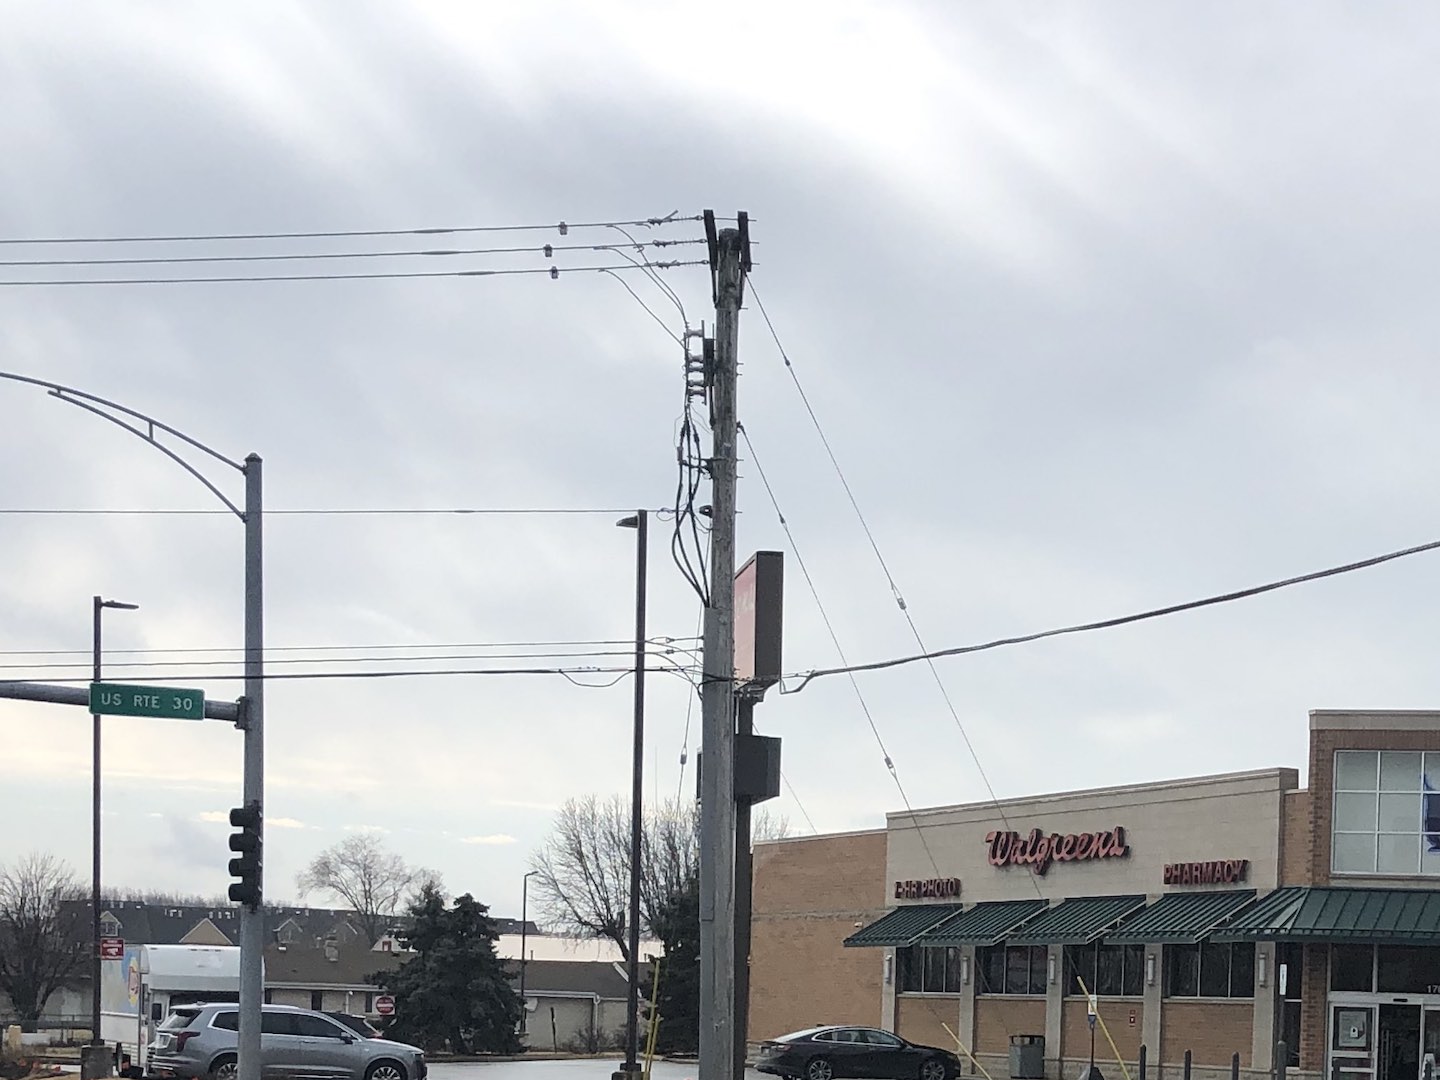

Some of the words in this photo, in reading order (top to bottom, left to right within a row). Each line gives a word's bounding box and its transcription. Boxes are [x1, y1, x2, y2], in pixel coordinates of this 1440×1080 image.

[101, 693, 122, 706] US
[133, 695, 160, 709] RTE
[172, 697, 193, 711] 30
[985, 826, 1129, 876] Walgreens
[1163, 860, 1248, 885] PHARMACY
[921, 878, 961, 897] PHOTO
